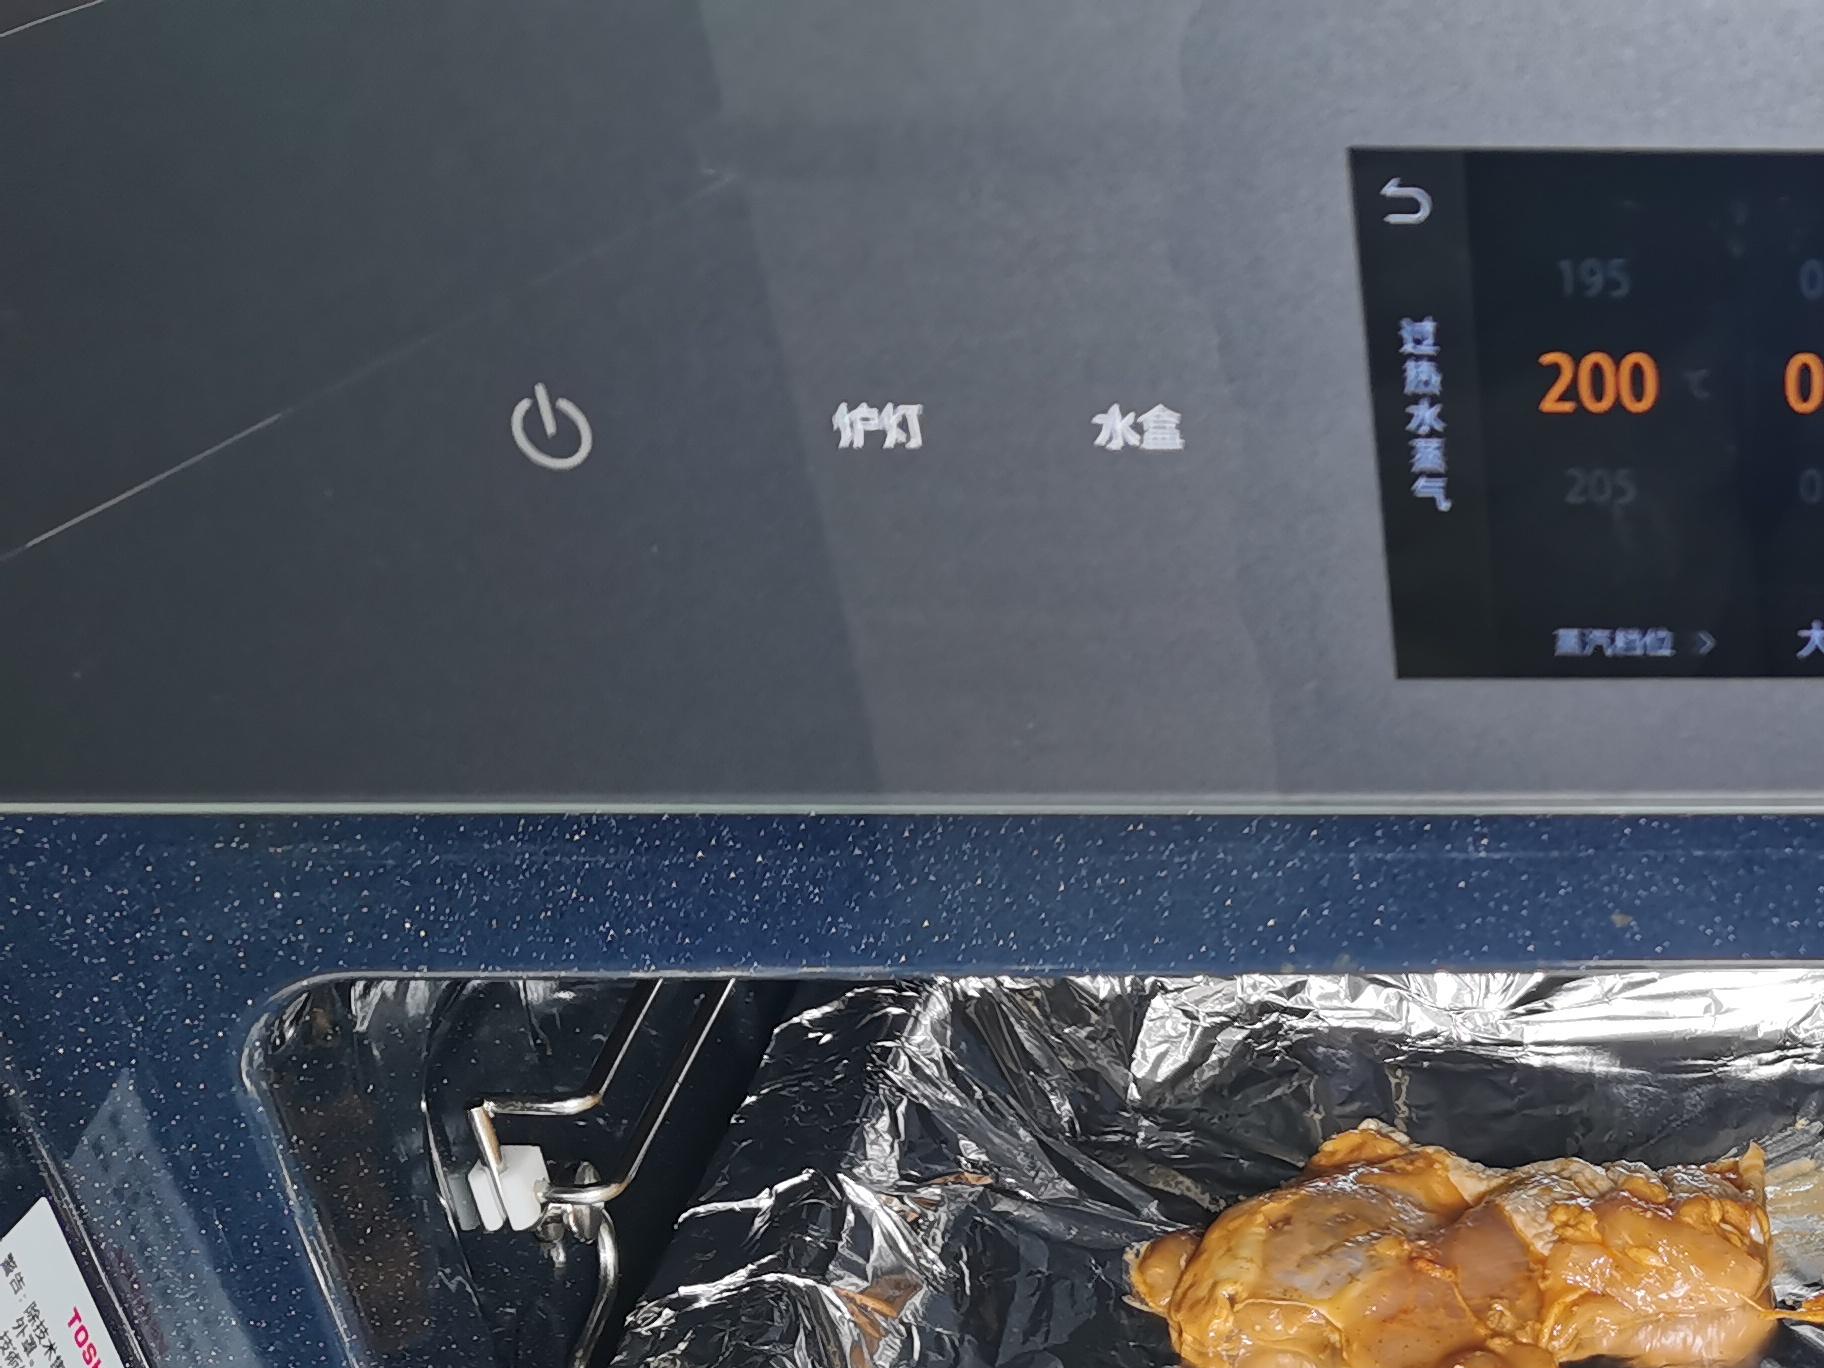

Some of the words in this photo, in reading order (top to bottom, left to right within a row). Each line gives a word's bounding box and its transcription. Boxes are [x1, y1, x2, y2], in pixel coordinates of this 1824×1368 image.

[1557, 258, 1633, 300] 195
[1537, 350, 1660, 416] 200
[833, 401, 924, 450] 炉灯
[1091, 402, 1185, 450] 水盒
[1564, 468, 1638, 507] 205
